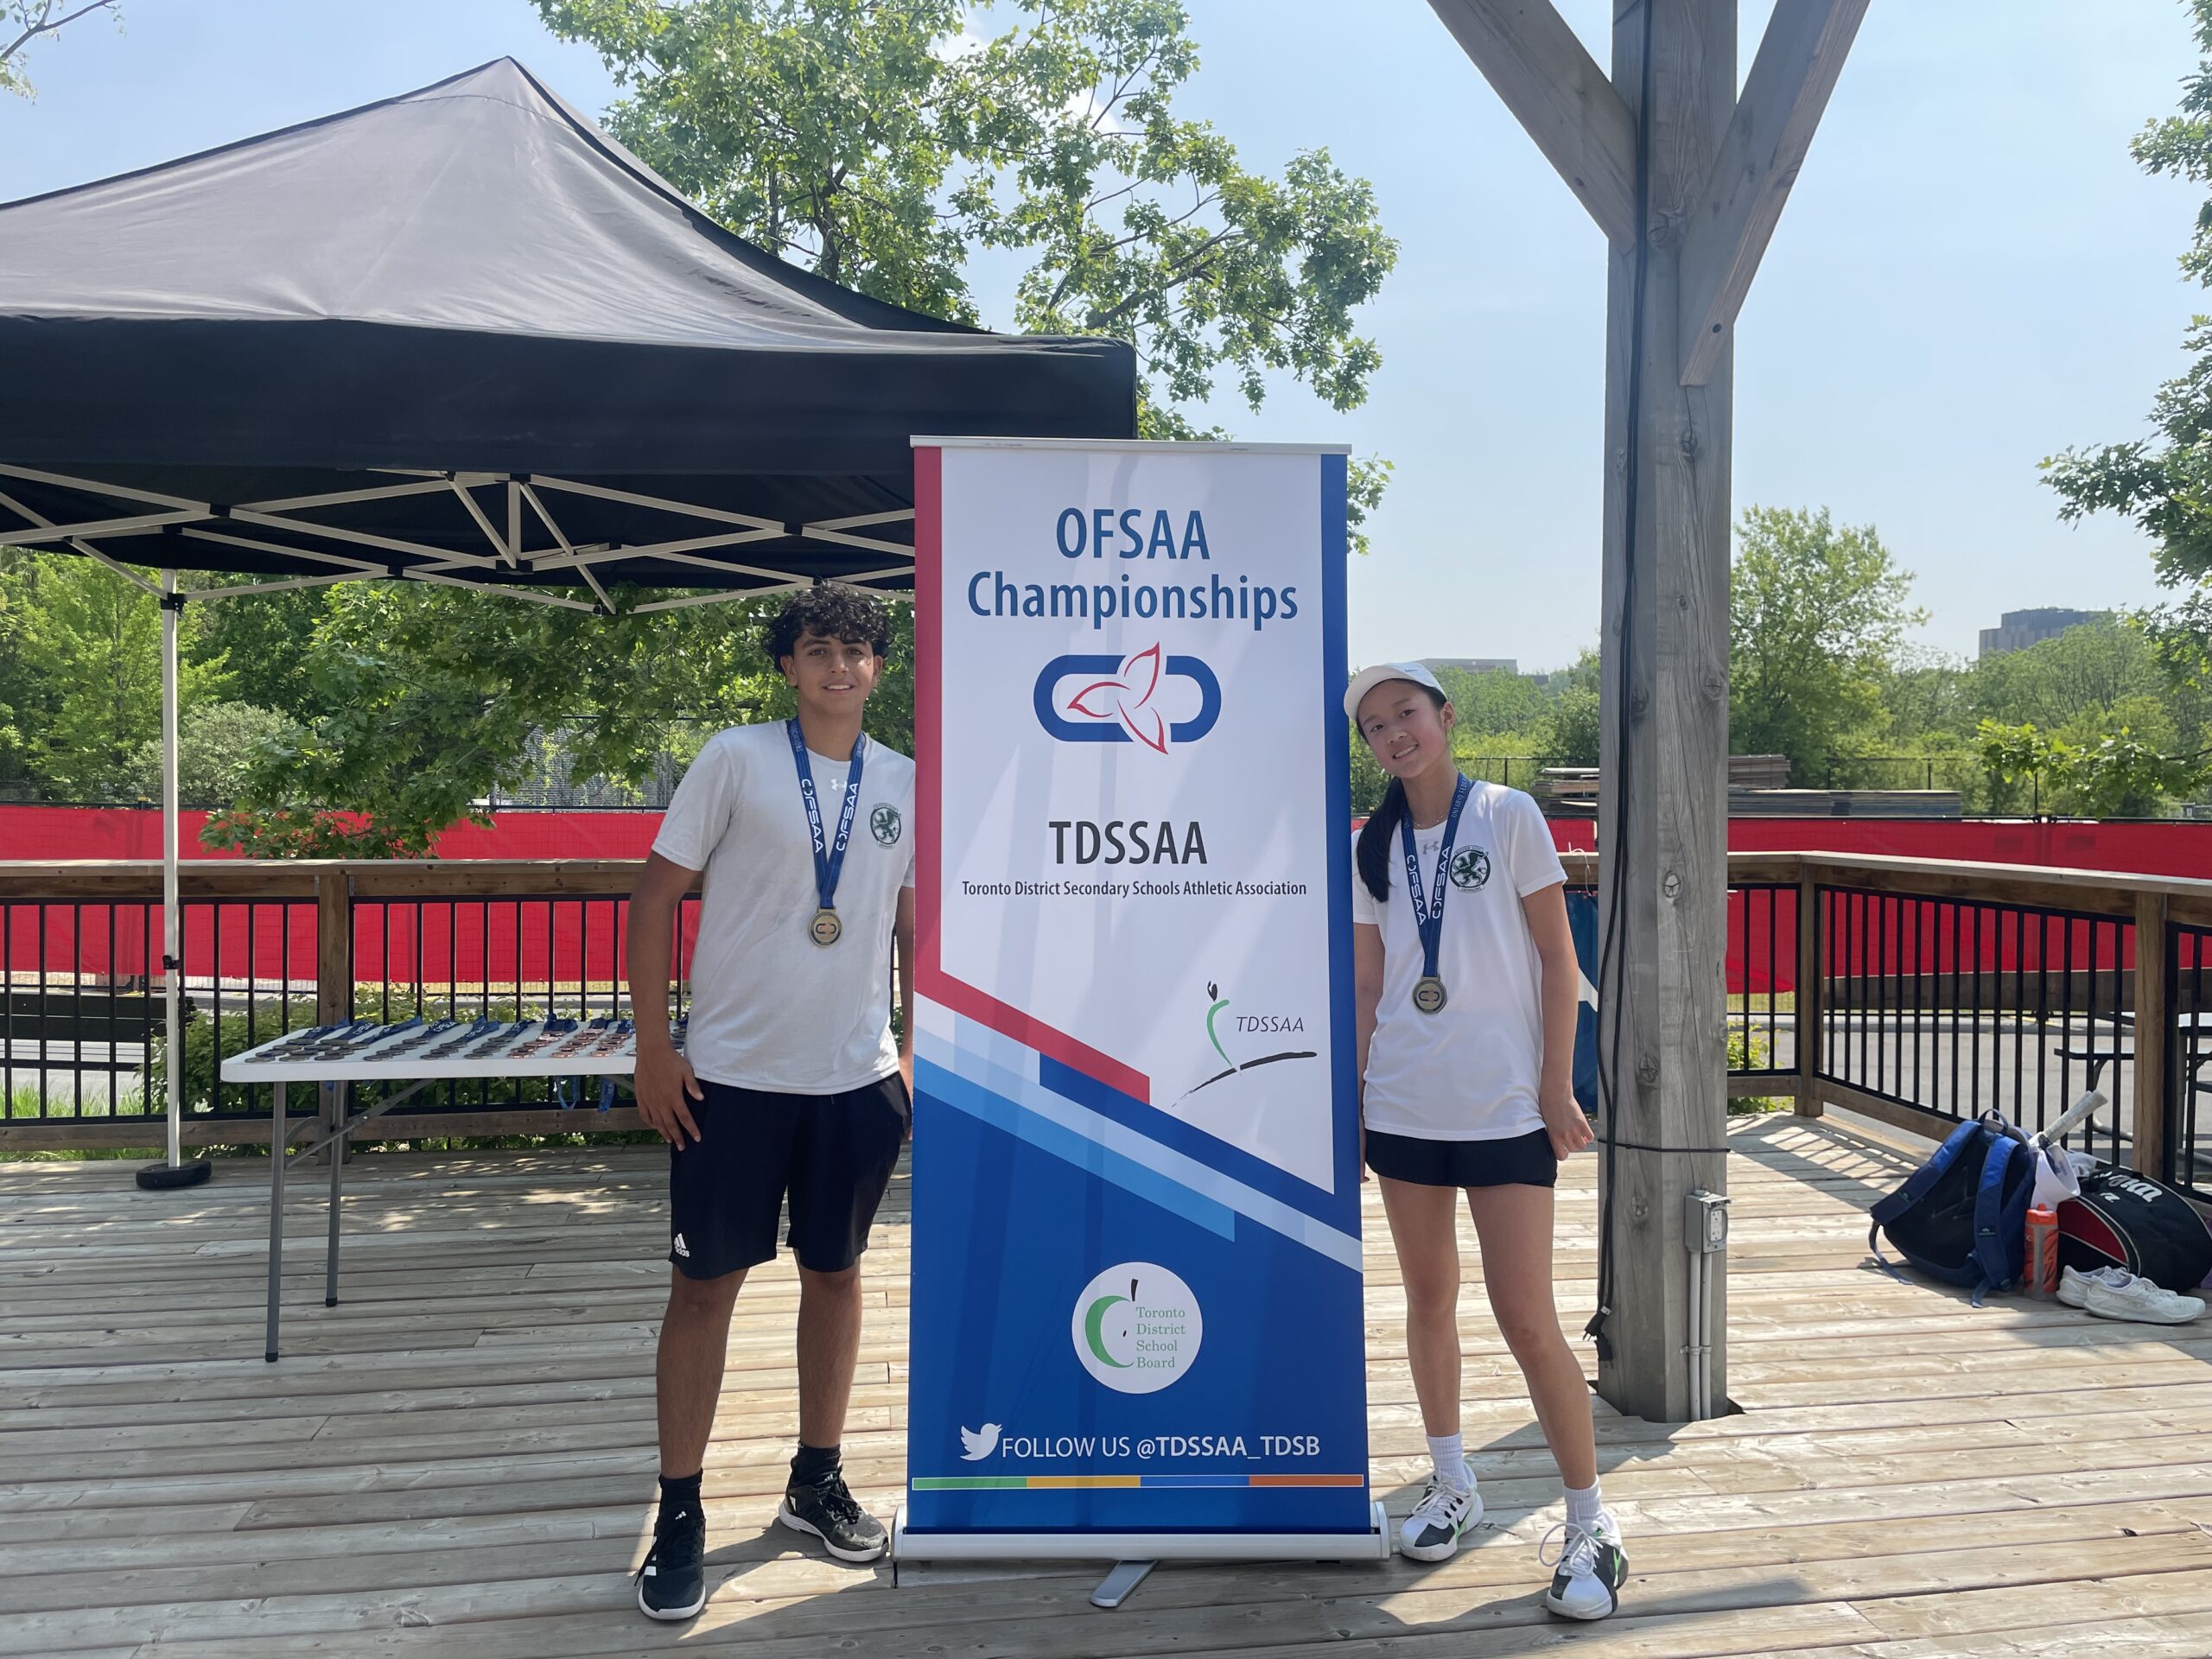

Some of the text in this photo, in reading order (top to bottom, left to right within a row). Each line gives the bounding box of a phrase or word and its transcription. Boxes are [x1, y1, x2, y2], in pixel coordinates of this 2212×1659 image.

[1056, 507, 1211, 560] OFSAA
[968, 570, 1299, 631] Championships
[1048, 820, 1208, 865] TDSSAA
[962, 880, 1307, 899] Toronto District Secondary Schools Athletic Association
[1236, 1015, 1305, 1033] TDSSAA
[1135, 1306, 1185, 1319] Toronto
[1135, 1323, 1186, 1335] District
[1135, 1339, 1178, 1351] School
[1136, 1357, 1176, 1369] Board
[1001, 1435, 1320, 1459] FOLLOW US @TDSSAA_TDSB
